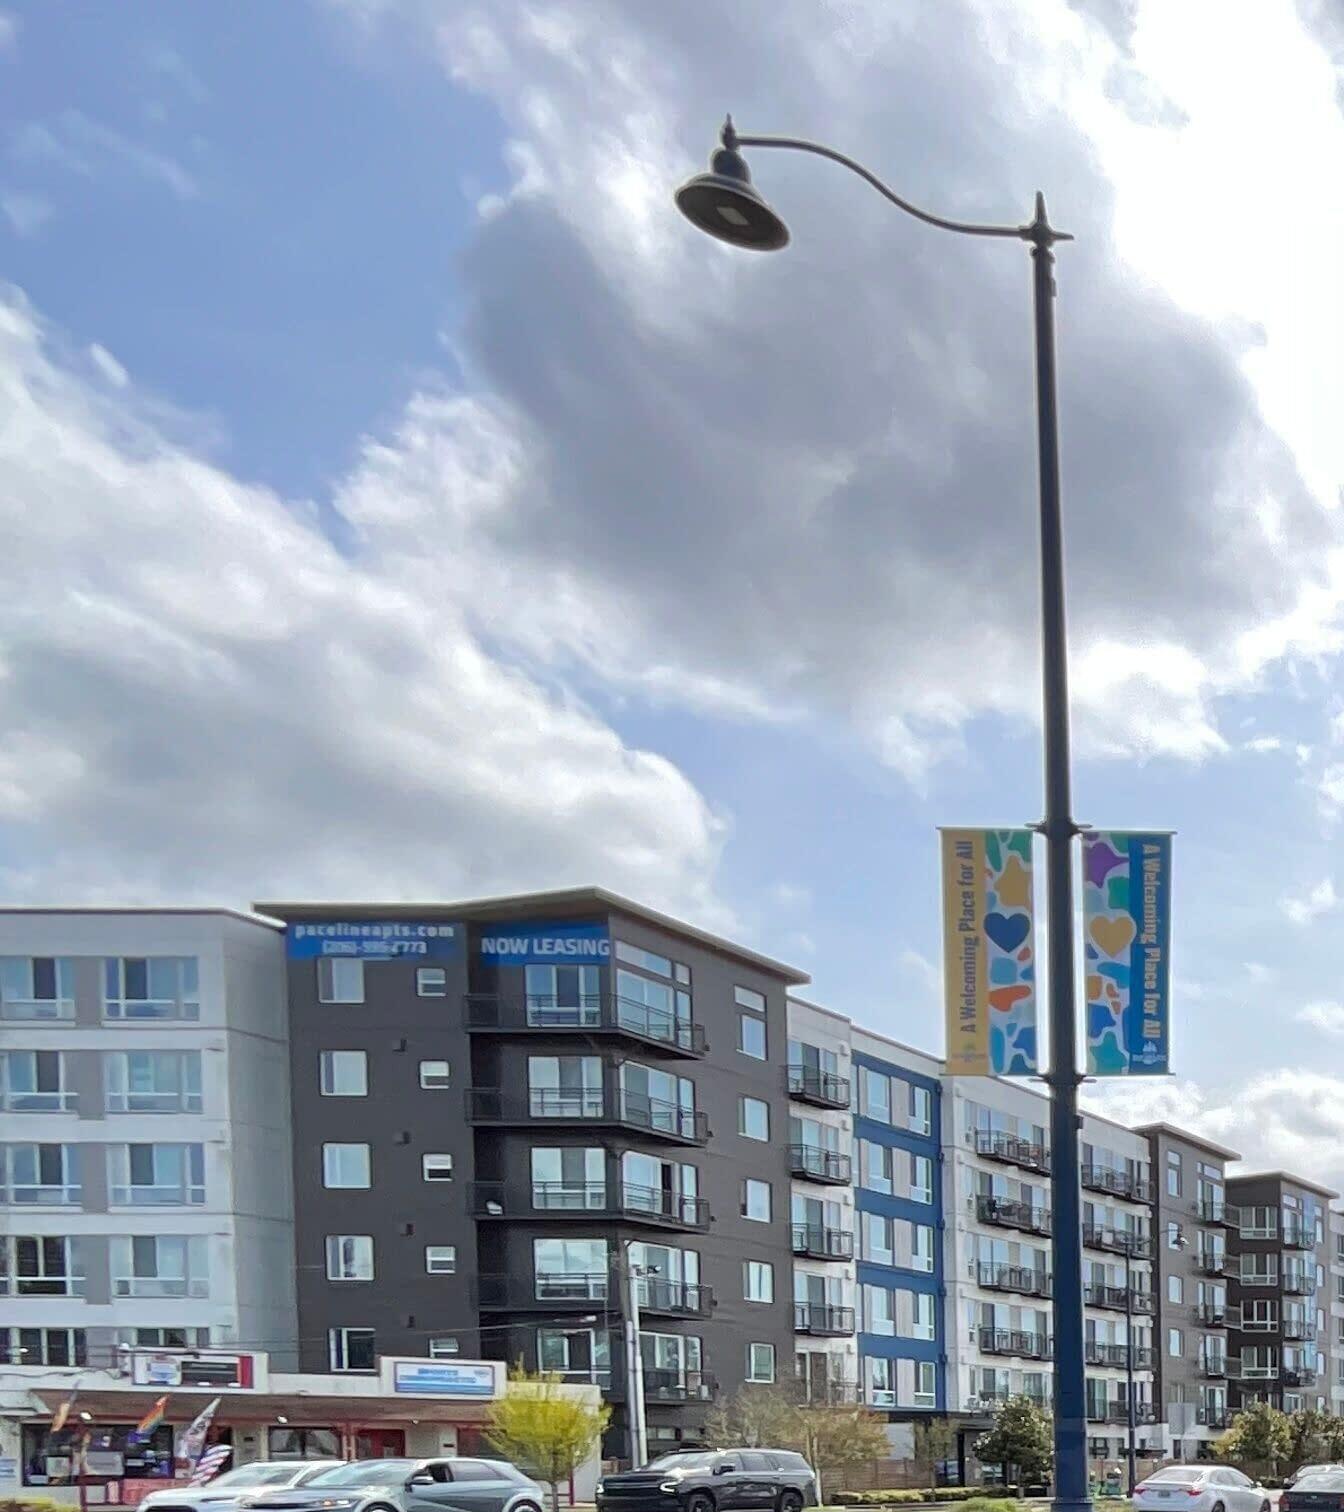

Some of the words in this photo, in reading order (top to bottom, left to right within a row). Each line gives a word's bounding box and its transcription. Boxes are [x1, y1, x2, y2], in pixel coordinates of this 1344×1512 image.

[956, 841, 974, 860] All
[1142, 844, 1160, 855] A
[958, 864, 975, 886] for
[959, 891, 976, 932] Place
[1140, 858, 1160, 944] Welcoming
[295, 922, 454, 939] pacelineapts.com
[481, 937, 528, 955] NOW
[533, 938, 610, 956] LEASING
[960, 936, 979, 1022] Welcoming
[1144, 947, 1160, 990] Place
[1144, 993, 1160, 1016] for
[960, 1023, 976, 1034] A
[1143, 1019, 1160, 1039] All
